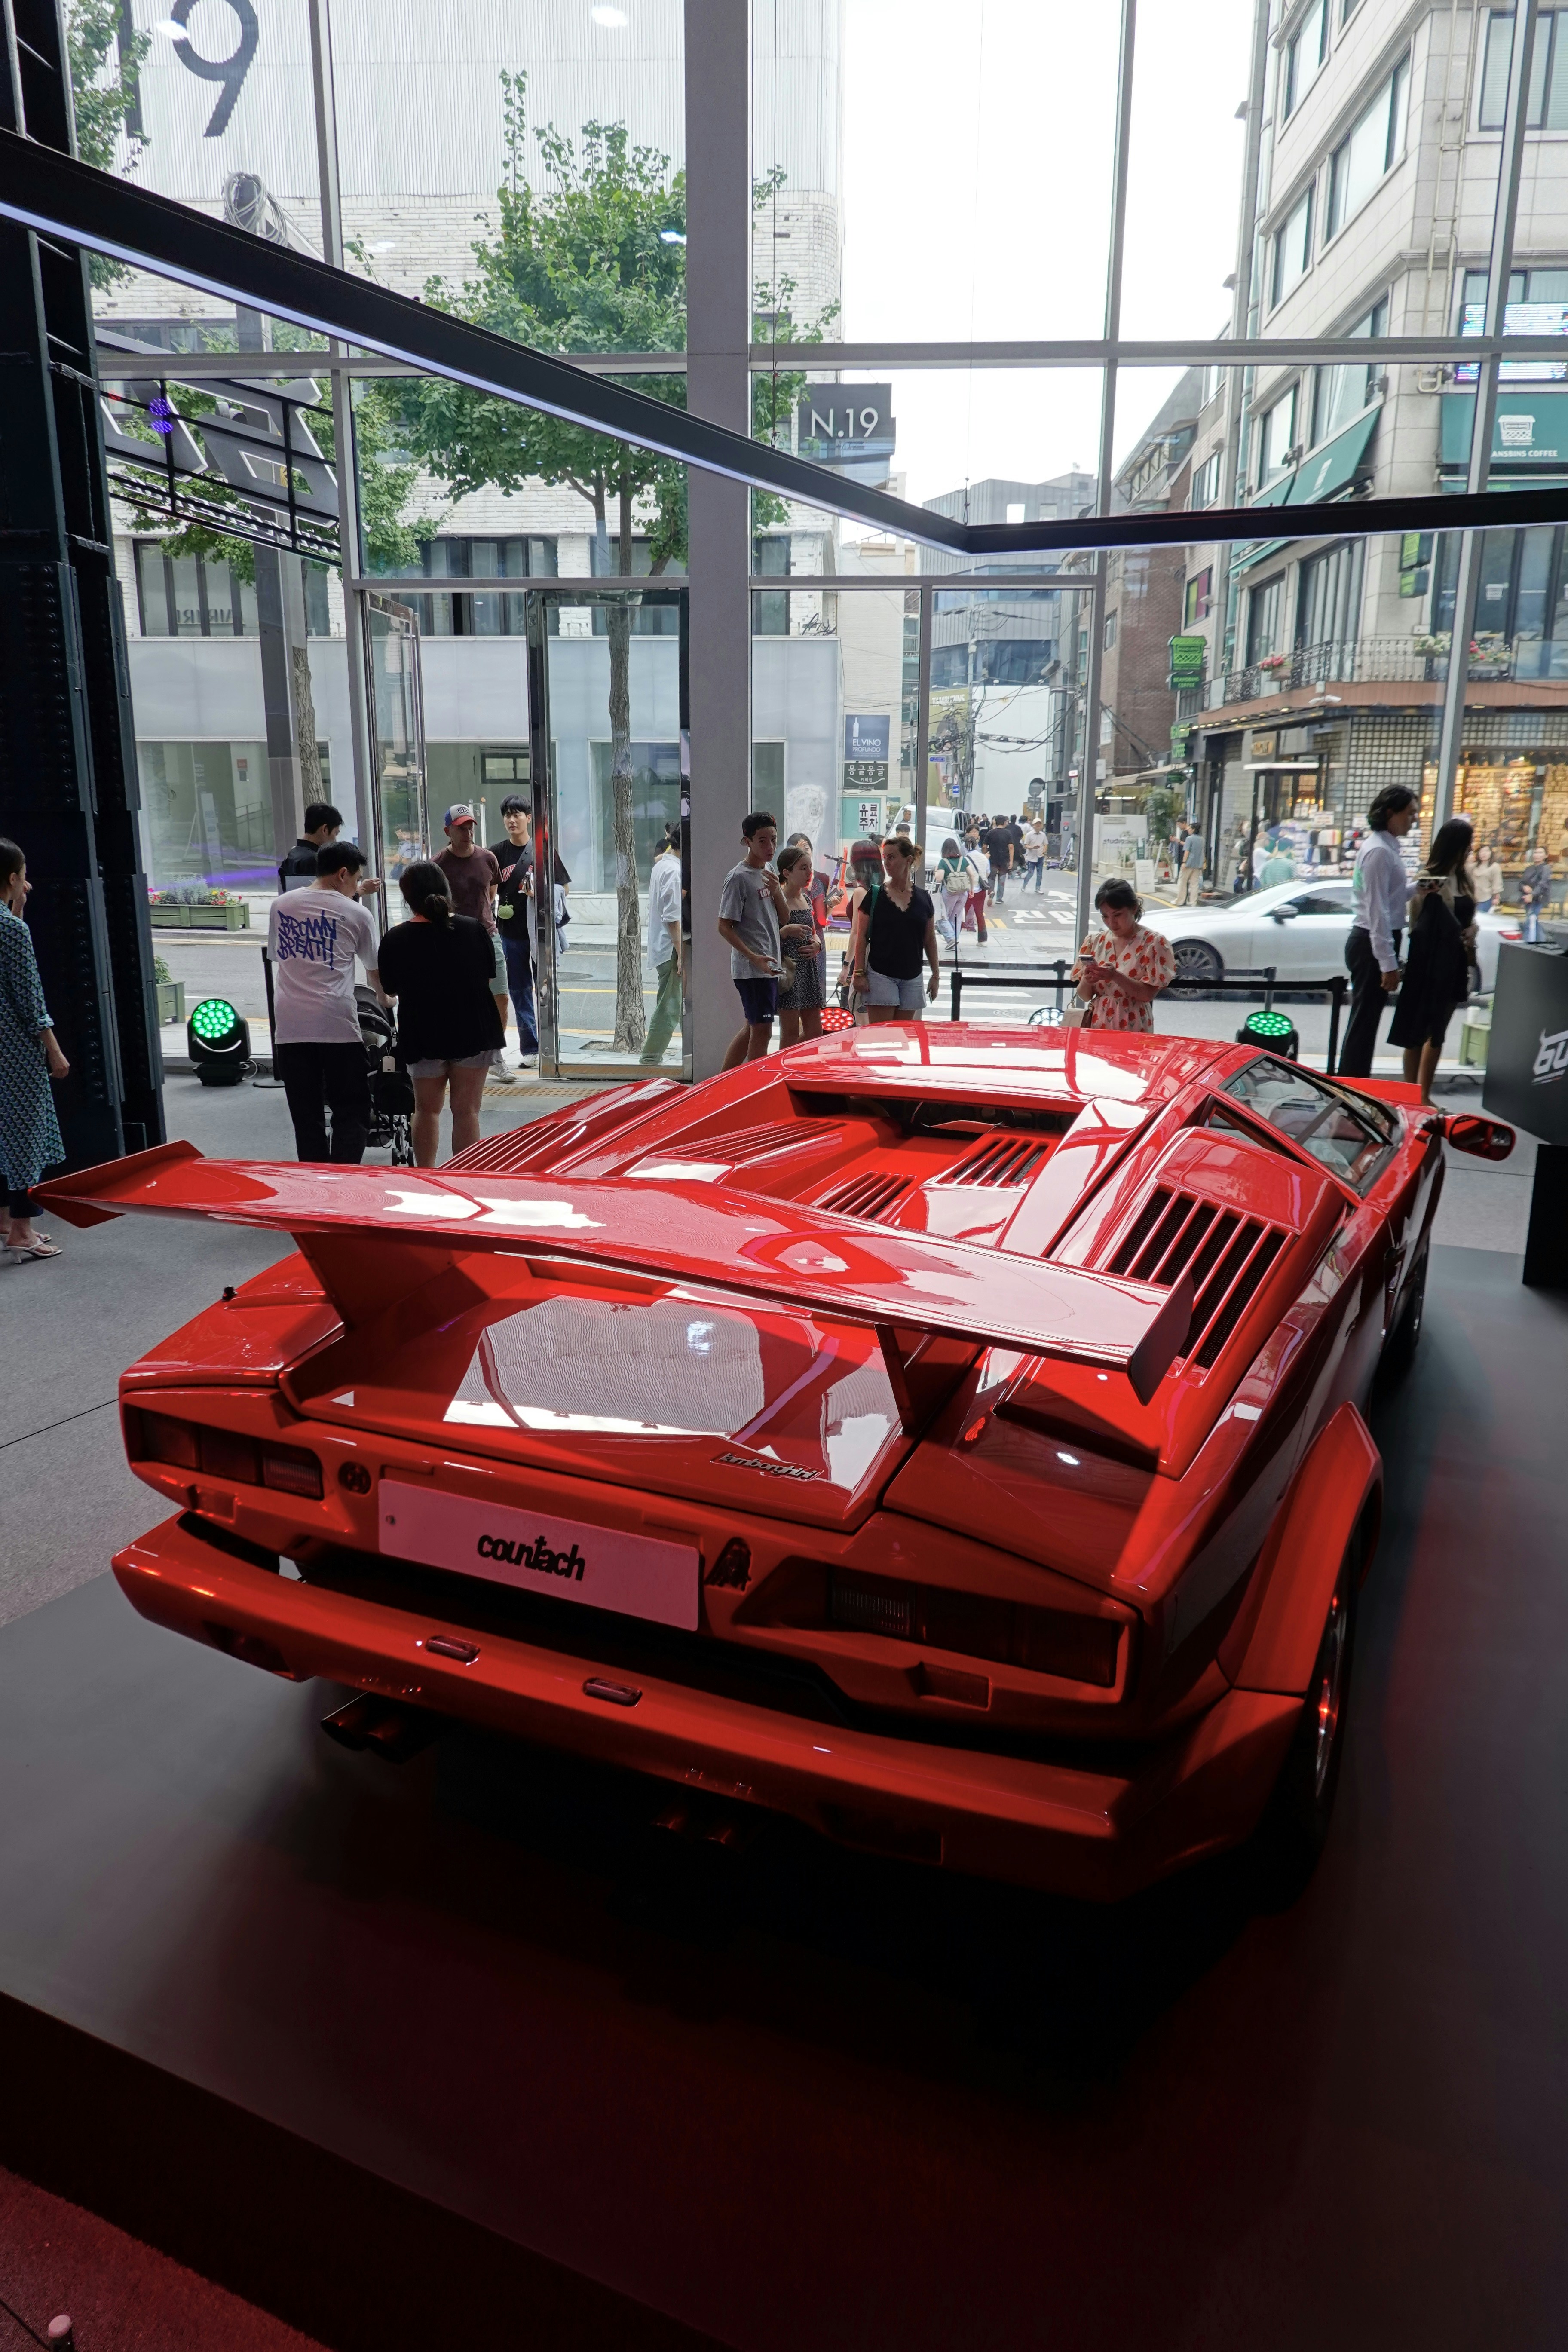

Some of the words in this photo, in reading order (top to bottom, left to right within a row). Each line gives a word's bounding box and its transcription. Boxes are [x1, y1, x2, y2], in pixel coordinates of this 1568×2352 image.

[812, 407, 879, 438] N.19
[848, 765, 885, 776] 몽글몽글
[860, 804, 877, 817] 유료
[860, 818, 878, 831] 주차
[277, 910, 337, 940] BROWN
[277, 933, 334, 971] BREATH
[477, 1534, 585, 1581] countach
